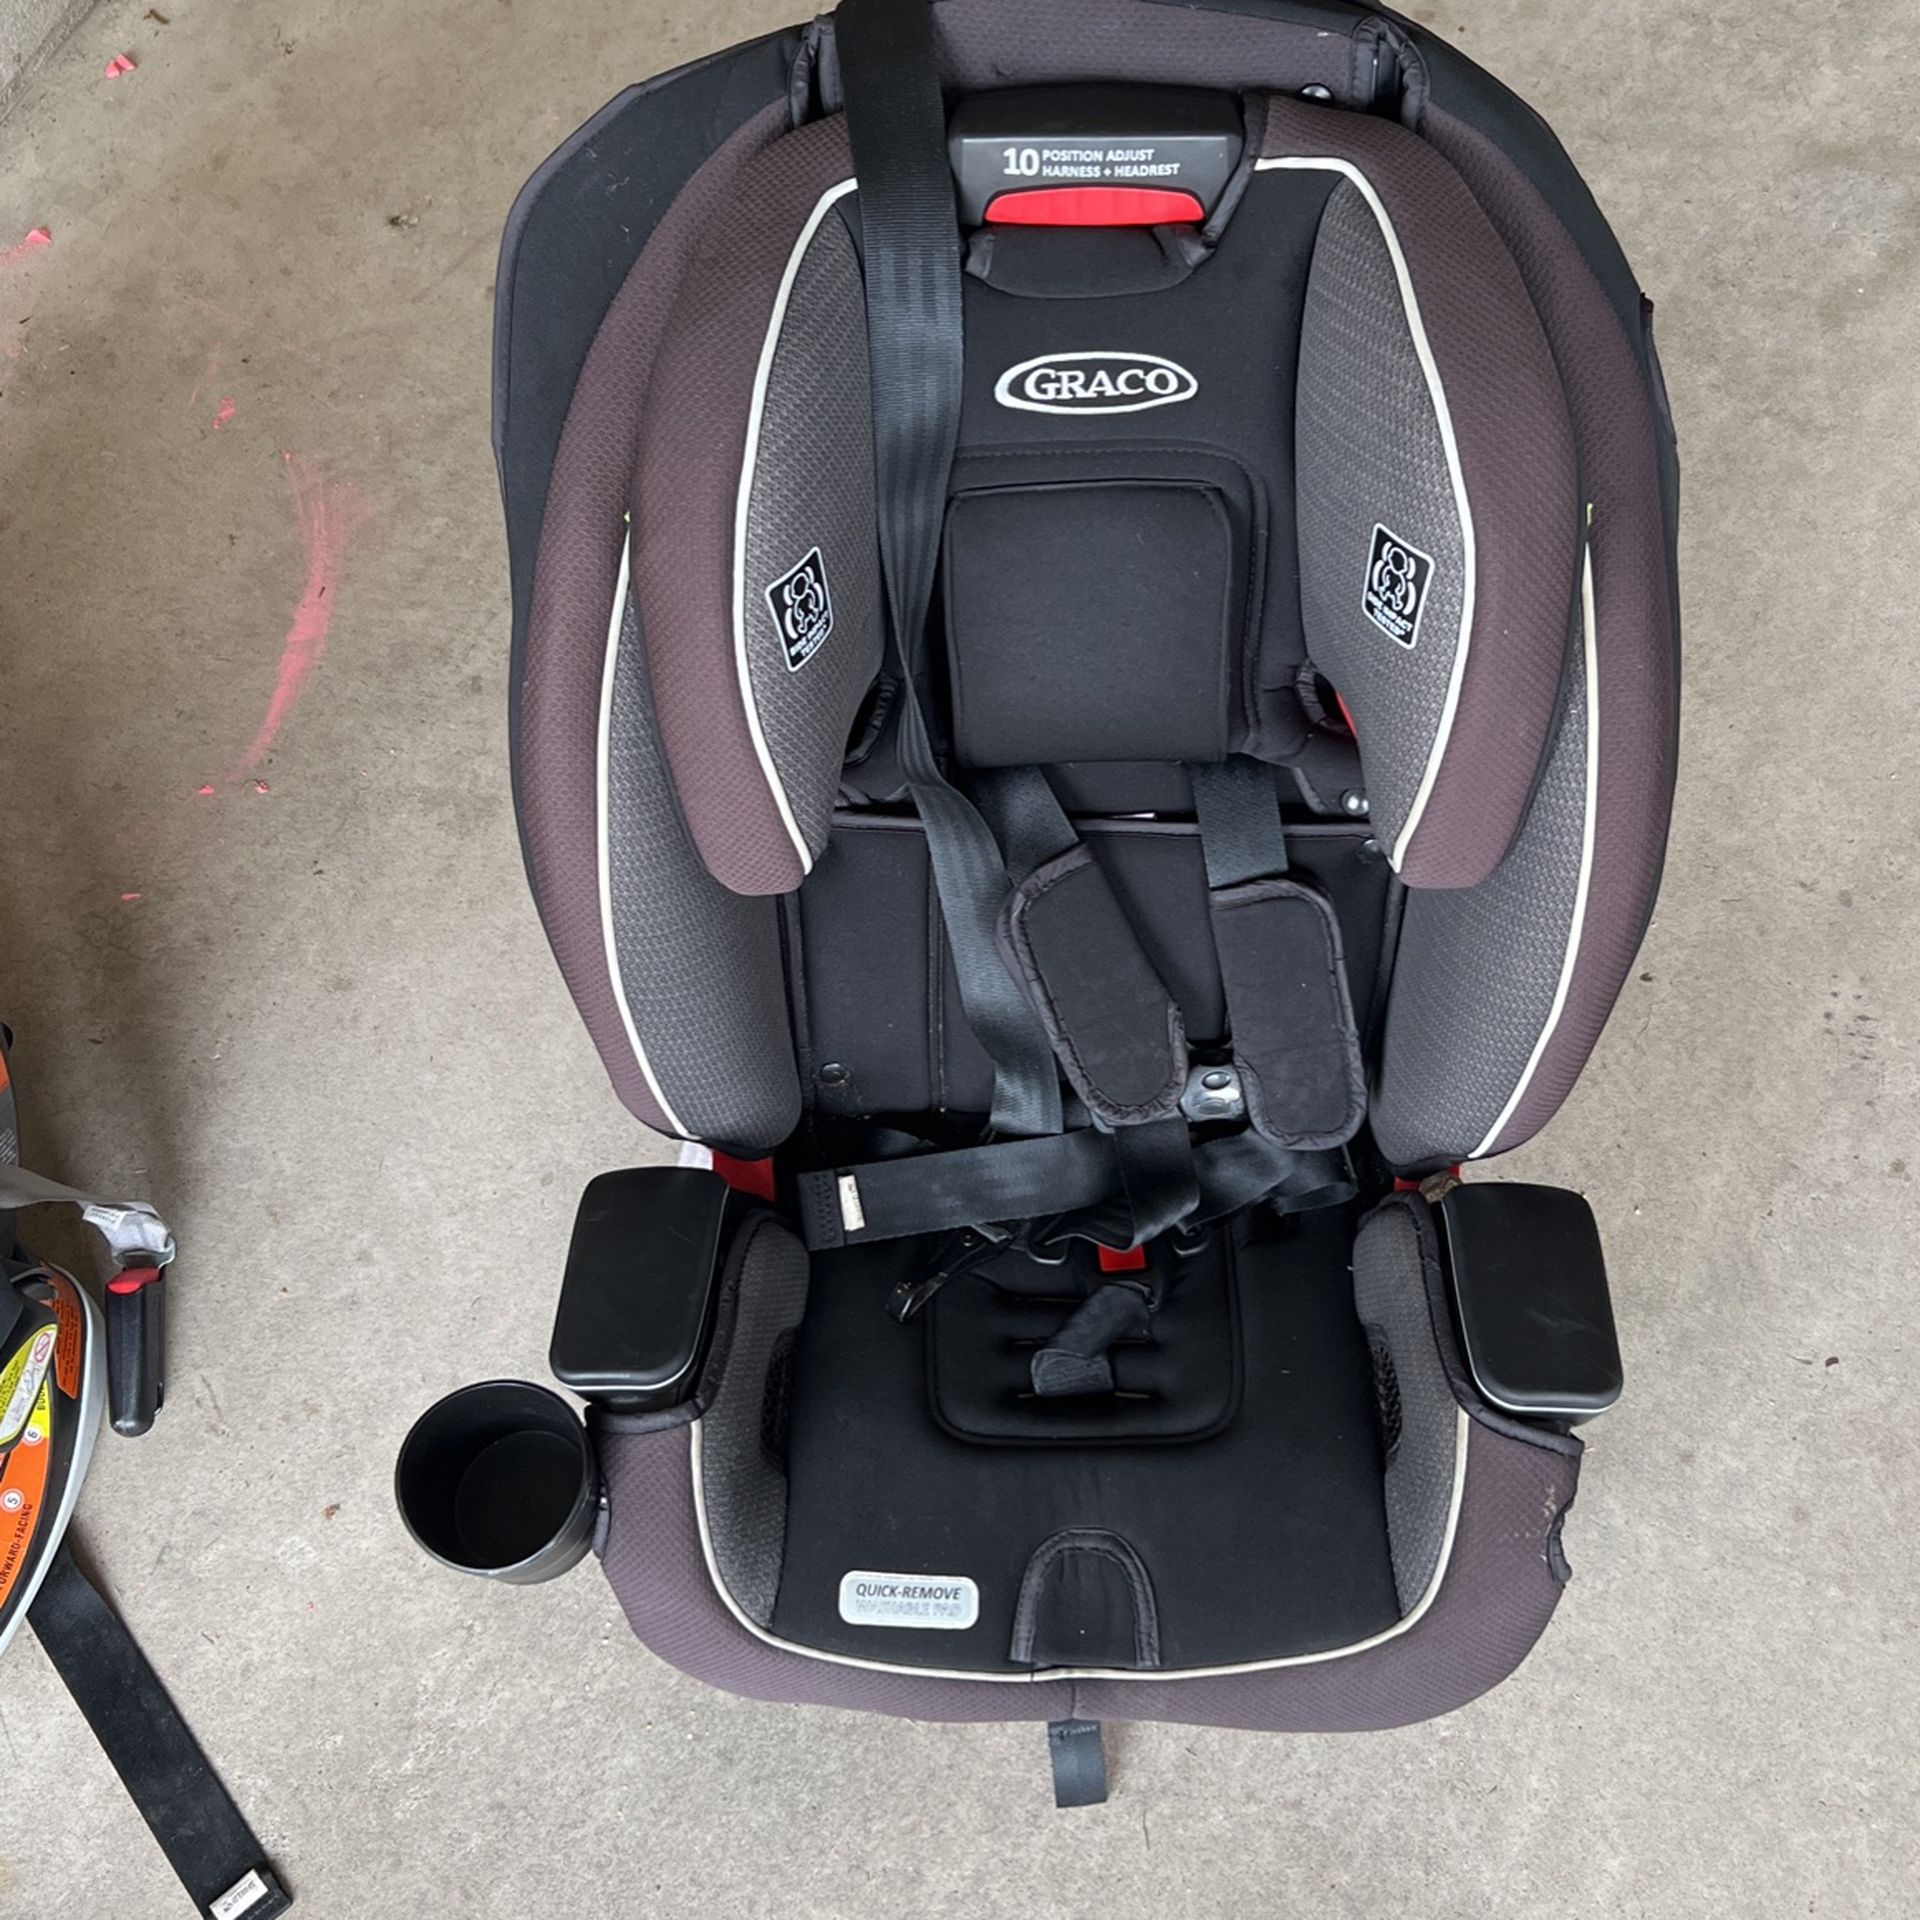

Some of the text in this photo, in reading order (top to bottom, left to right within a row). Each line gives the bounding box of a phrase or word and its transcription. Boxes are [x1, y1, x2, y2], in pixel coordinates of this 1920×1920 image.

[1003, 147, 1040, 176] 10
[1042, 148, 1154, 162] POSITION ADJUST
[1042, 165, 1100, 178] HARNESS
[1114, 163, 1180, 178] HEADREST
[1024, 368, 1178, 400] GRACO
[8, 1496, 18, 1505] 5
[856, 1583, 962, 1600] QUICK-REMOVE
